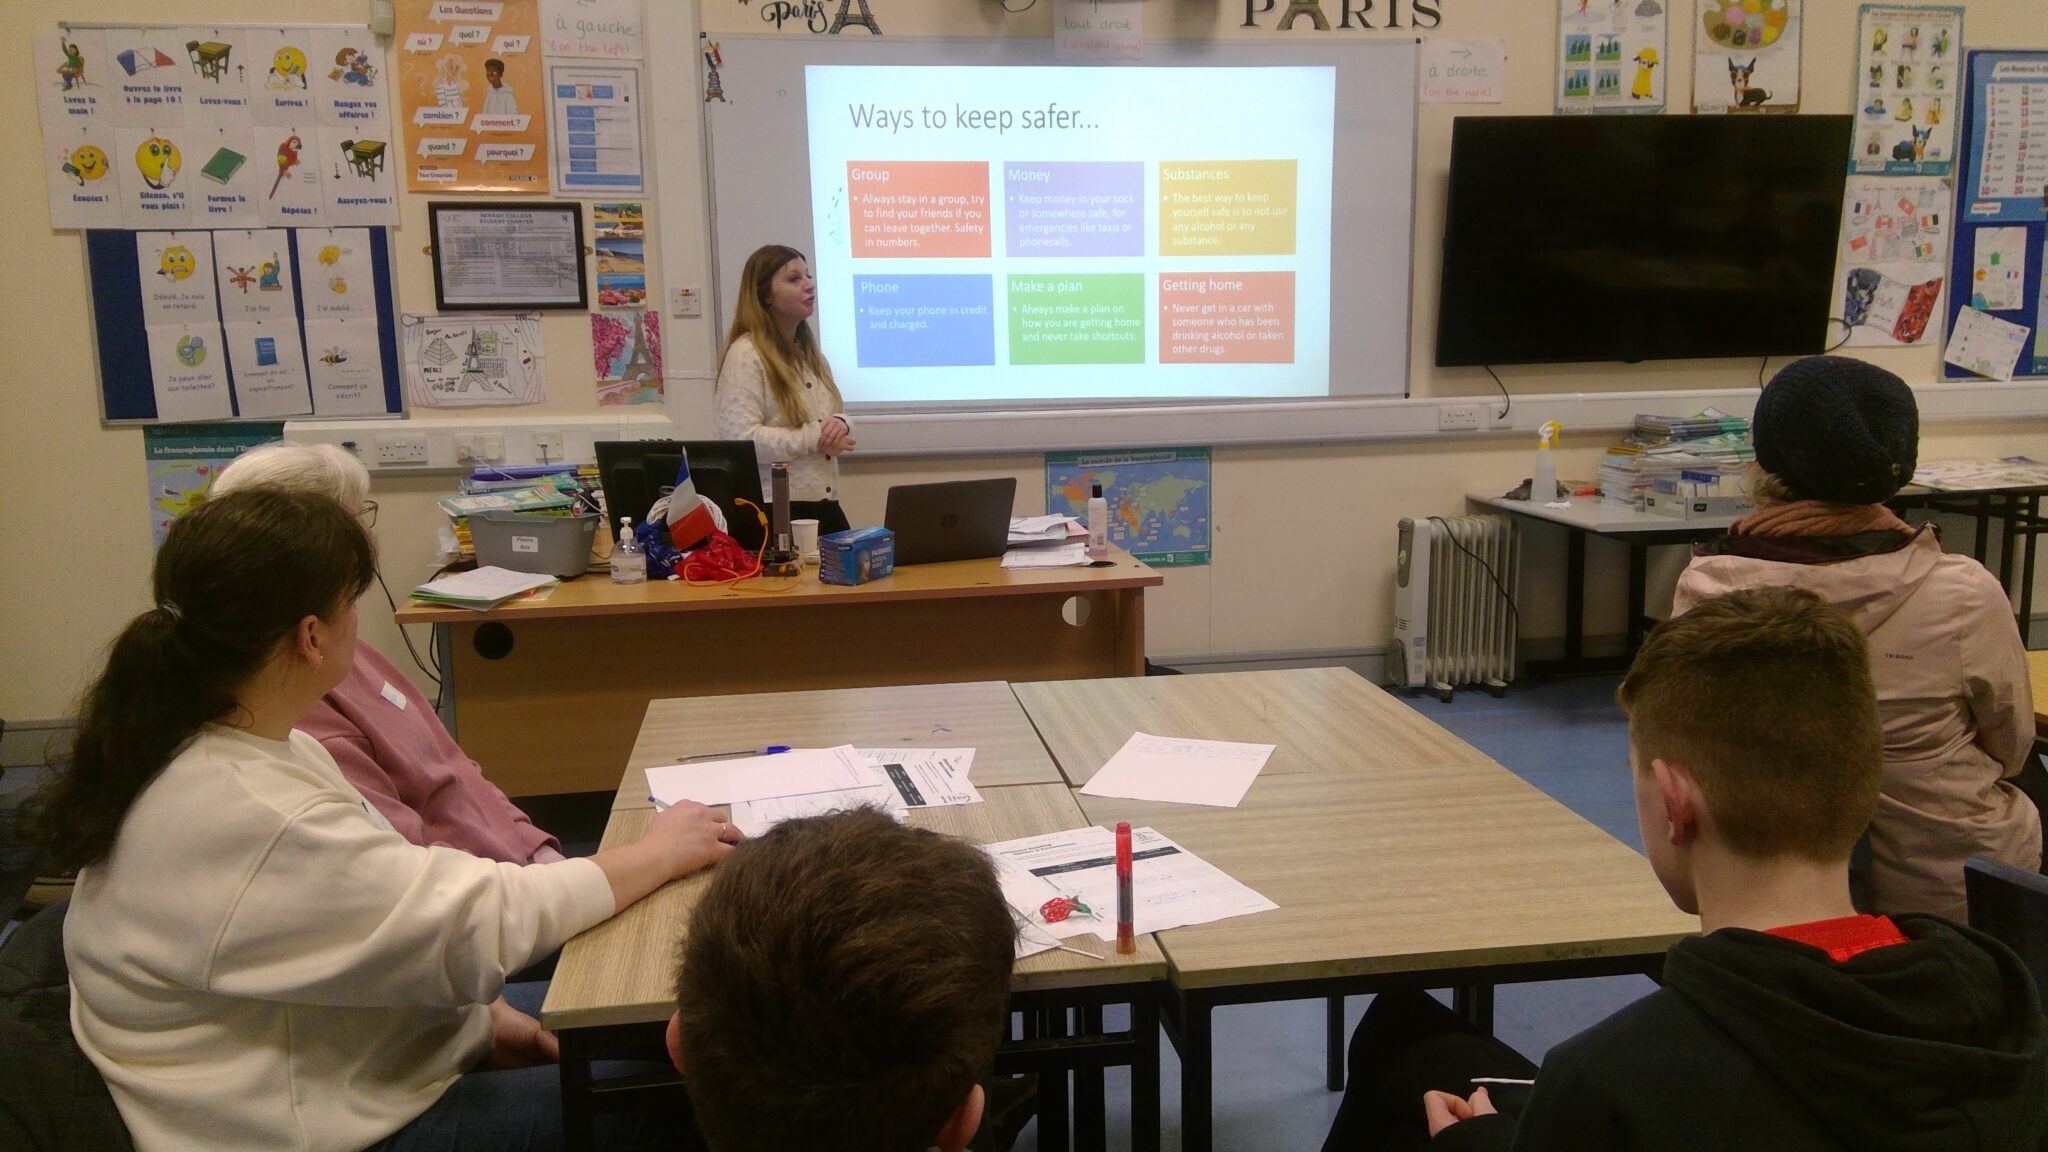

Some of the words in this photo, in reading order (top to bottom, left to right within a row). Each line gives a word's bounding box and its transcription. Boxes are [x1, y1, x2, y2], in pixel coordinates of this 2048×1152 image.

[439, 5, 454, 14] Les
[455, 6, 493, 16] Questions
[761, 0, 828, 33] Paris
[556, 12, 567, 31] à
[576, 19, 636, 40] gauche
[458, 31, 475, 39] quel
[503, 40, 514, 49] qui
[123, 85, 151, 93] Ouvrez
[153, 85, 161, 93] le
[163, 85, 182, 93] livre
[64, 96, 86, 104] Levez
[89, 96, 96, 104] la
[200, 97, 242, 106] Levez-vous
[334, 100, 362, 110] Rangez
[422, 112, 454, 120] combien
[849, 103, 914, 135] Ways
[922, 106, 947, 129] to
[956, 103, 1013, 135] keep
[1021, 103, 1100, 129] safer...
[480, 119, 515, 127] comment
[427, 143, 450, 152] quand
[486, 149, 519, 158] pourquoi
[851, 168, 890, 184] Group
[1008, 169, 1051, 185] Money
[1162, 168, 1230, 181] Substances
[207, 195, 236, 203] Fermez
[238, 195, 246, 203] le
[337, 196, 388, 205] Asseyez-vous
[863, 194, 896, 206] Always
[897, 195, 917, 206] stay
[918, 195, 929, 204] in
[938, 197, 969, 207] group,
[971, 196, 985, 207] try
[1018, 195, 1043, 207] Keep
[1044, 196, 1077, 206] money
[1078, 194, 1089, 204] in
[1090, 196, 1112, 206] your
[1113, 194, 1135, 204] sock
[1172, 192, 1190, 203] The
[1192, 192, 1212, 203] best
[1214, 194, 1233, 204] way
[1235, 194, 1246, 203] to
[1247, 192, 1270, 205] keep
[863, 208, 874, 218] to
[876, 208, 895, 218] find
[896, 210, 919, 220] your
[920, 208, 953, 218] friends
[955, 208, 962, 218] if
[963, 210, 983, 220] you
[1018, 209, 1030, 219] or
[1031, 208, 1087, 219] somewhere
[1089, 208, 1111, 221] safe,
[1112, 208, 1127, 219] for
[1172, 206, 1210, 218] yourself
[1211, 206, 1231, 218] safe
[1232, 207, 1241, 217] is
[1242, 207, 1252, 217] to
[1254, 207, 1271, 217] not
[1272, 207, 1288, 217] use
[864, 224, 881, 233] can
[883, 222, 908, 233] leave
[910, 223, 952, 236] together.
[953, 222, 984, 236] Safety
[1018, 223, 1079, 236] emergencies
[1080, 222, 1098, 233] like
[1099, 223, 1119, 233] taxis
[1121, 224, 1133, 233] or
[1172, 222, 1190, 233] any
[1191, 220, 1226, 232] alcohol
[1227, 222, 1238, 232] or
[1239, 222, 1256, 234] any
[865, 237, 875, 248] in
[861, 280, 900, 295] Phone
[1012, 280, 1045, 293] Make
[1047, 282, 1055, 293] a
[1057, 279, 1084, 296] plan
[1163, 279, 1206, 294] Getting
[1208, 278, 1243, 292] home
[868, 305, 893, 319] Keep
[894, 308, 915, 319] your
[917, 305, 947, 319] phone
[949, 306, 959, 316] in
[960, 304, 989, 316] credit
[1022, 304, 1053, 316] Always
[1055, 303, 1081, 314] make
[1082, 305, 1089, 314] a
[1090, 303, 1111, 316] plan
[1112, 305, 1125, 314] on
[1172, 303, 1200, 313] Never
[1201, 305, 1217, 315] get
[1218, 304, 1227, 313] in
[1228, 305, 1236, 313] a
[1237, 304, 1252, 312] car
[1253, 302, 1274, 313] with
[869, 319, 888, 330] and
[1022, 317, 1043, 328] how
[1044, 319, 1062, 330] you
[1063, 319, 1079, 328] are
[1080, 318, 1113, 330] getting
[1114, 316, 1141, 327] home
[1172, 317, 1215, 327] someone
[1216, 316, 1237, 327] who
[1238, 316, 1256, 327] has
[1257, 315, 1280, 327] been
[1022, 331, 1040, 342] and
[1042, 333, 1068, 342] never
[1070, 331, 1091, 342] take
[1172, 331, 1210, 343] drinking
[1212, 330, 1245, 341] alcohol
[1246, 331, 1257, 341] or
[1258, 330, 1285, 340] taken
[1172, 344, 1198, 355] other
[164, 446, 215, 455] francophonie
